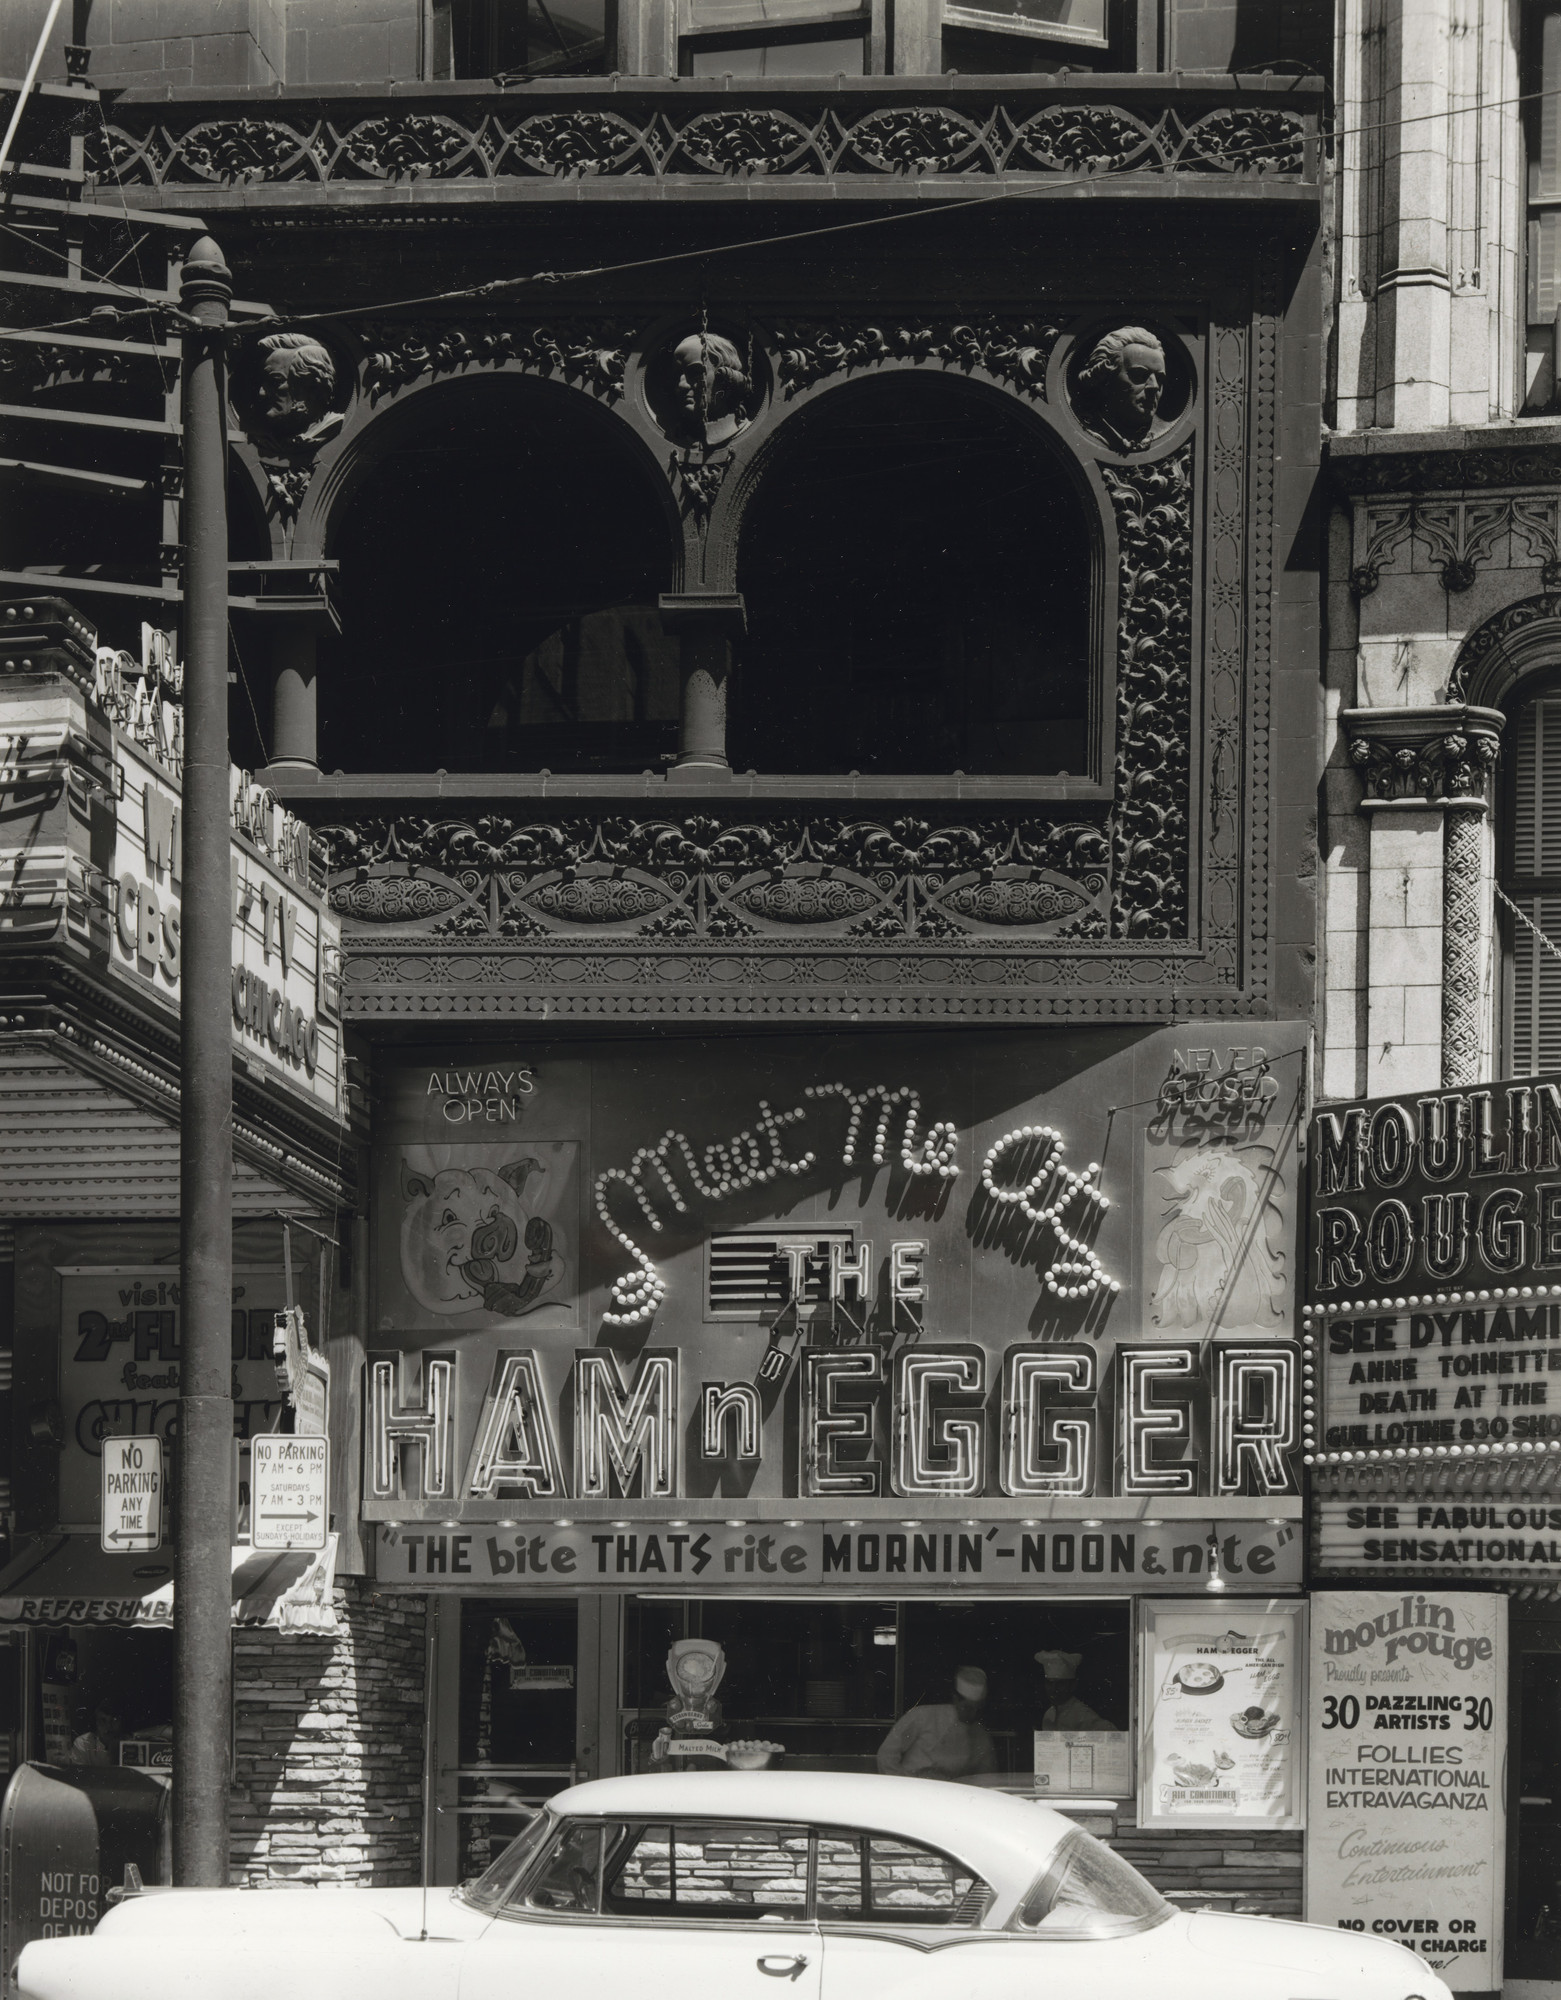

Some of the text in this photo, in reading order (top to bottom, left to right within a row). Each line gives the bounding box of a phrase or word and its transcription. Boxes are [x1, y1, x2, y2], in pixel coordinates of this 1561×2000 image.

[117, 871, 182, 979] CBS
[232, 963, 318, 1070] CHICAGO
[1172, 1046, 1267, 1073] NEVER
[427, 1070, 533, 1095] ALWAYS
[1161, 1075, 1279, 1105] CLOSED
[443, 1098, 516, 1122] OPEN
[1315, 1083, 1561, 1196] MOULIN
[1315, 1182, 1561, 1291] ROUGE
[775, 1238, 933, 1302] THE
[1328, 1317, 1397, 1354] SEE
[1349, 1347, 1561, 1384] ANNE TOINETTE
[1359, 1382, 1548, 1414] DEATH AT THE
[364, 1346, 684, 1499] HAM
[799, 1340, 1301, 1500] EGGER
[1326, 1418, 1455, 1448] GUILLOTINE
[1459, 1415, 1509, 1440] 830
[122, 1448, 143, 1469] NO
[257, 1446, 324, 1460] NO PARKING
[260, 1463, 267, 1474] 7
[271, 1463, 284, 1474] AM
[296, 1463, 304, 1474] 6
[310, 1463, 322, 1474] PM
[107, 1471, 158, 1494] PARKING
[270, 1483, 310, 1492] SATURDAYS
[121, 1497, 143, 1512] ANY
[260, 1494, 267, 1505] 7
[271, 1494, 283, 1505] AM
[297, 1494, 304, 1506] 3
[310, 1494, 322, 1505] PM
[121, 1515, 143, 1529] TIME
[276, 1524, 303, 1532] EXCEPT
[1347, 1507, 1561, 1531] SEE FABULOUS
[486, 1535, 577, 1577] bite
[723, 1534, 808, 1573] rite
[1363, 1539, 1561, 1563] SENSATIONAL
[1324, 1595, 1456, 1656] moulin
[1385, 1631, 1493, 1671] rouge
[1324, 1661, 1414, 1686] Proudly presents
[1321, 1694, 1360, 1730] 30
[1365, 1695, 1462, 1711] DAZZLING
[1463, 1695, 1493, 1731] 30
[1373, 1714, 1450, 1730] ARTISTS
[1357, 1744, 1463, 1765] FOLLIES
[1325, 1768, 1490, 1789] INTERNATIONAL
[1172, 1790, 1186, 1799] AIR
[1190, 1790, 1236, 1799] CONDITIONED
[1326, 1791, 1489, 1811] EXTRAVAGANZA
[1338, 1829, 1449, 1860] Continuous
[41, 1872, 74, 1893] NOT
[1341, 1859, 1488, 1889] Entertainment
[1338, 1919, 1476, 1934] NO COVER OR
[1421, 1939, 1487, 1953] CHARGE
